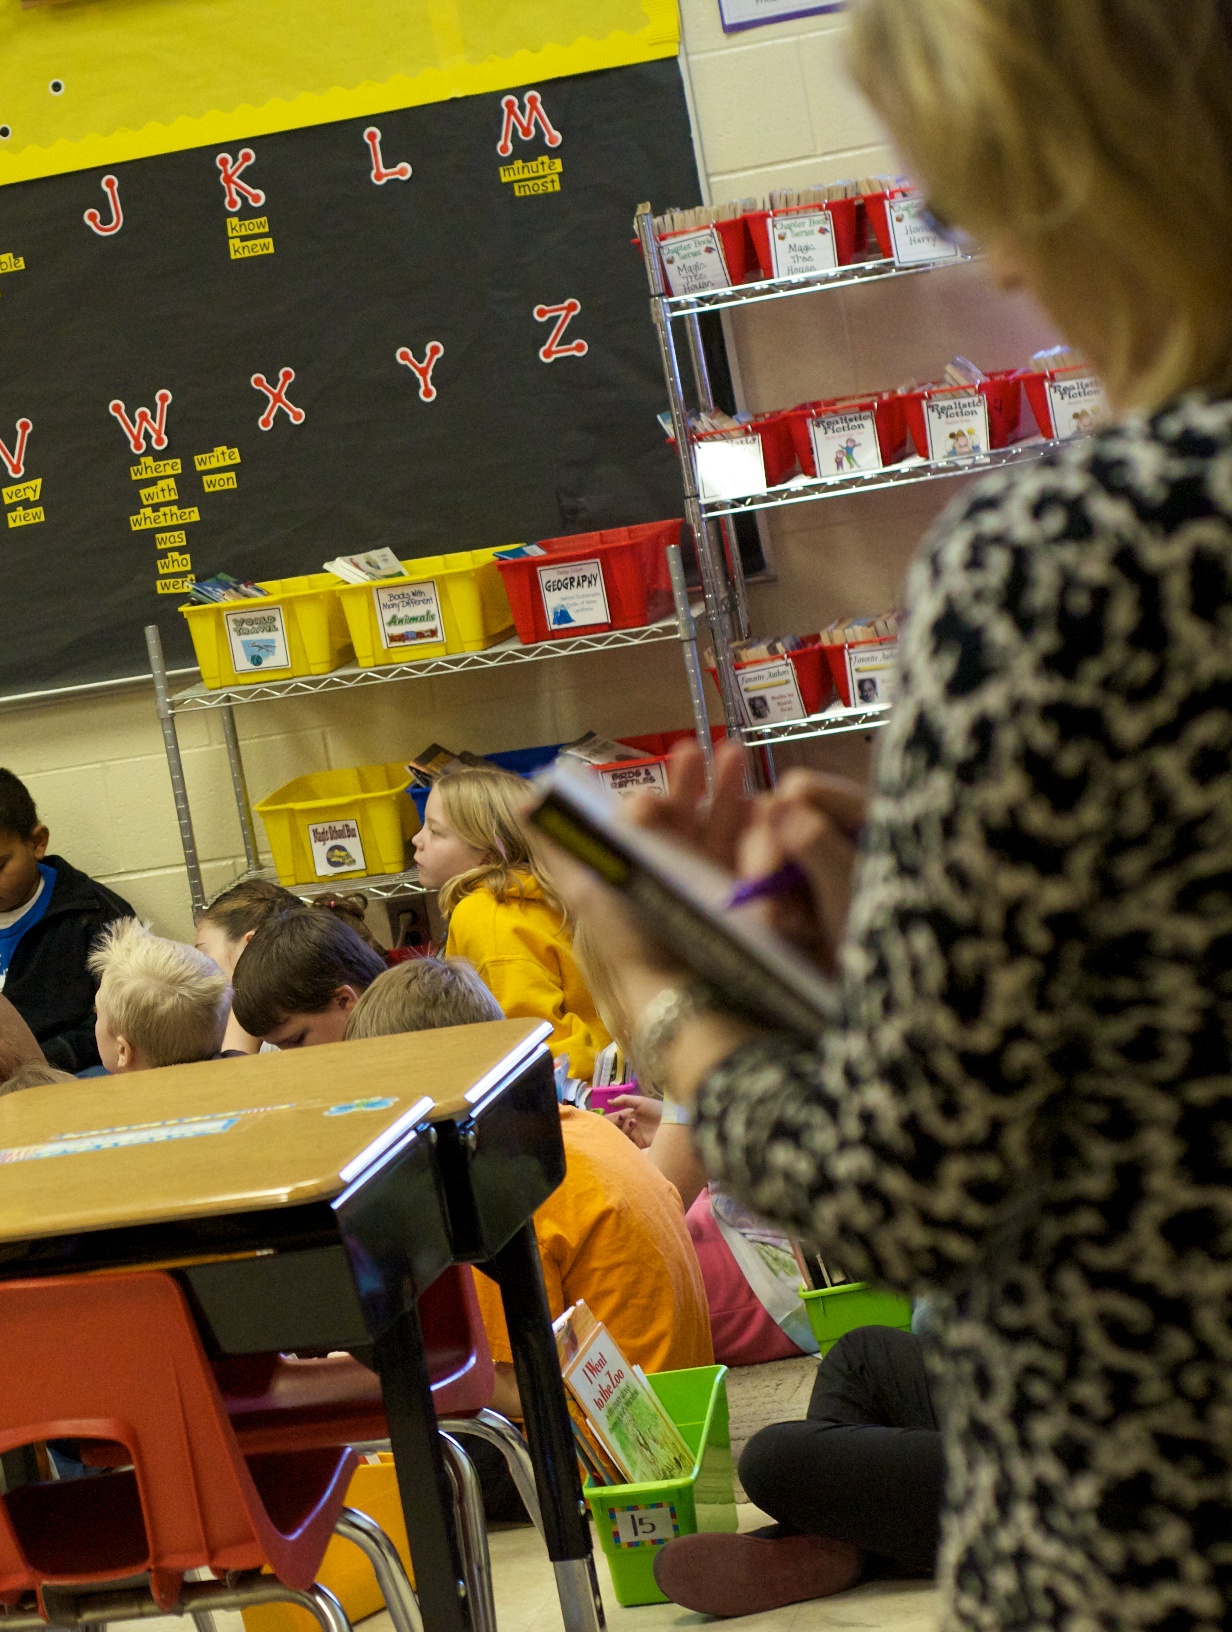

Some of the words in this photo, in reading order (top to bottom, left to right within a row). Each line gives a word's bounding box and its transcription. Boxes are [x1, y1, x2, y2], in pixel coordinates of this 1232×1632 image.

[496, 90, 563, 157] M
[363, 127, 413, 185] L
[502, 158, 558, 178] minute
[216, 148, 265, 211] K
[517, 178, 558, 194] most
[84, 175, 123, 236] J
[229, 219, 267, 234] know
[232, 239, 272, 257] knew
[533, 298, 589, 363] Z
[395, 340, 445, 402] Y
[250, 367, 306, 431] X
[930, 400, 983, 412] Realistic
[108, 388, 173, 454] W
[818, 413, 872, 427] Realistic
[937, 408, 978, 419] Fiction
[823, 423, 865, 435] Fiction
[196, 449, 237, 467] write
[132, 459, 180, 477] where
[206, 475, 235, 489] won
[5, 484, 38, 501] very
[143, 483, 176, 502] with
[10, 508, 42, 523] view
[131, 508, 195, 528] whether
[157, 532, 184, 547] was
[159, 553, 189, 570] who
[545, 573, 598, 592] GEOGRAPHY
[388, 591, 410, 602] Books
[232, 616, 276, 626] WORLD
[386, 610, 436, 626] Animals
[233, 624, 279, 636] TRAVEL
[611, 769, 642, 781] BIRDS
[585, 1351, 608, 1379] Went
[582, 1368, 594, 1385] I
[605, 1369, 625, 1389] Zoo
[598, 1383, 614, 1402] the
[593, 1398, 605, 1412] to
[630, 1514, 656, 1537] 15
